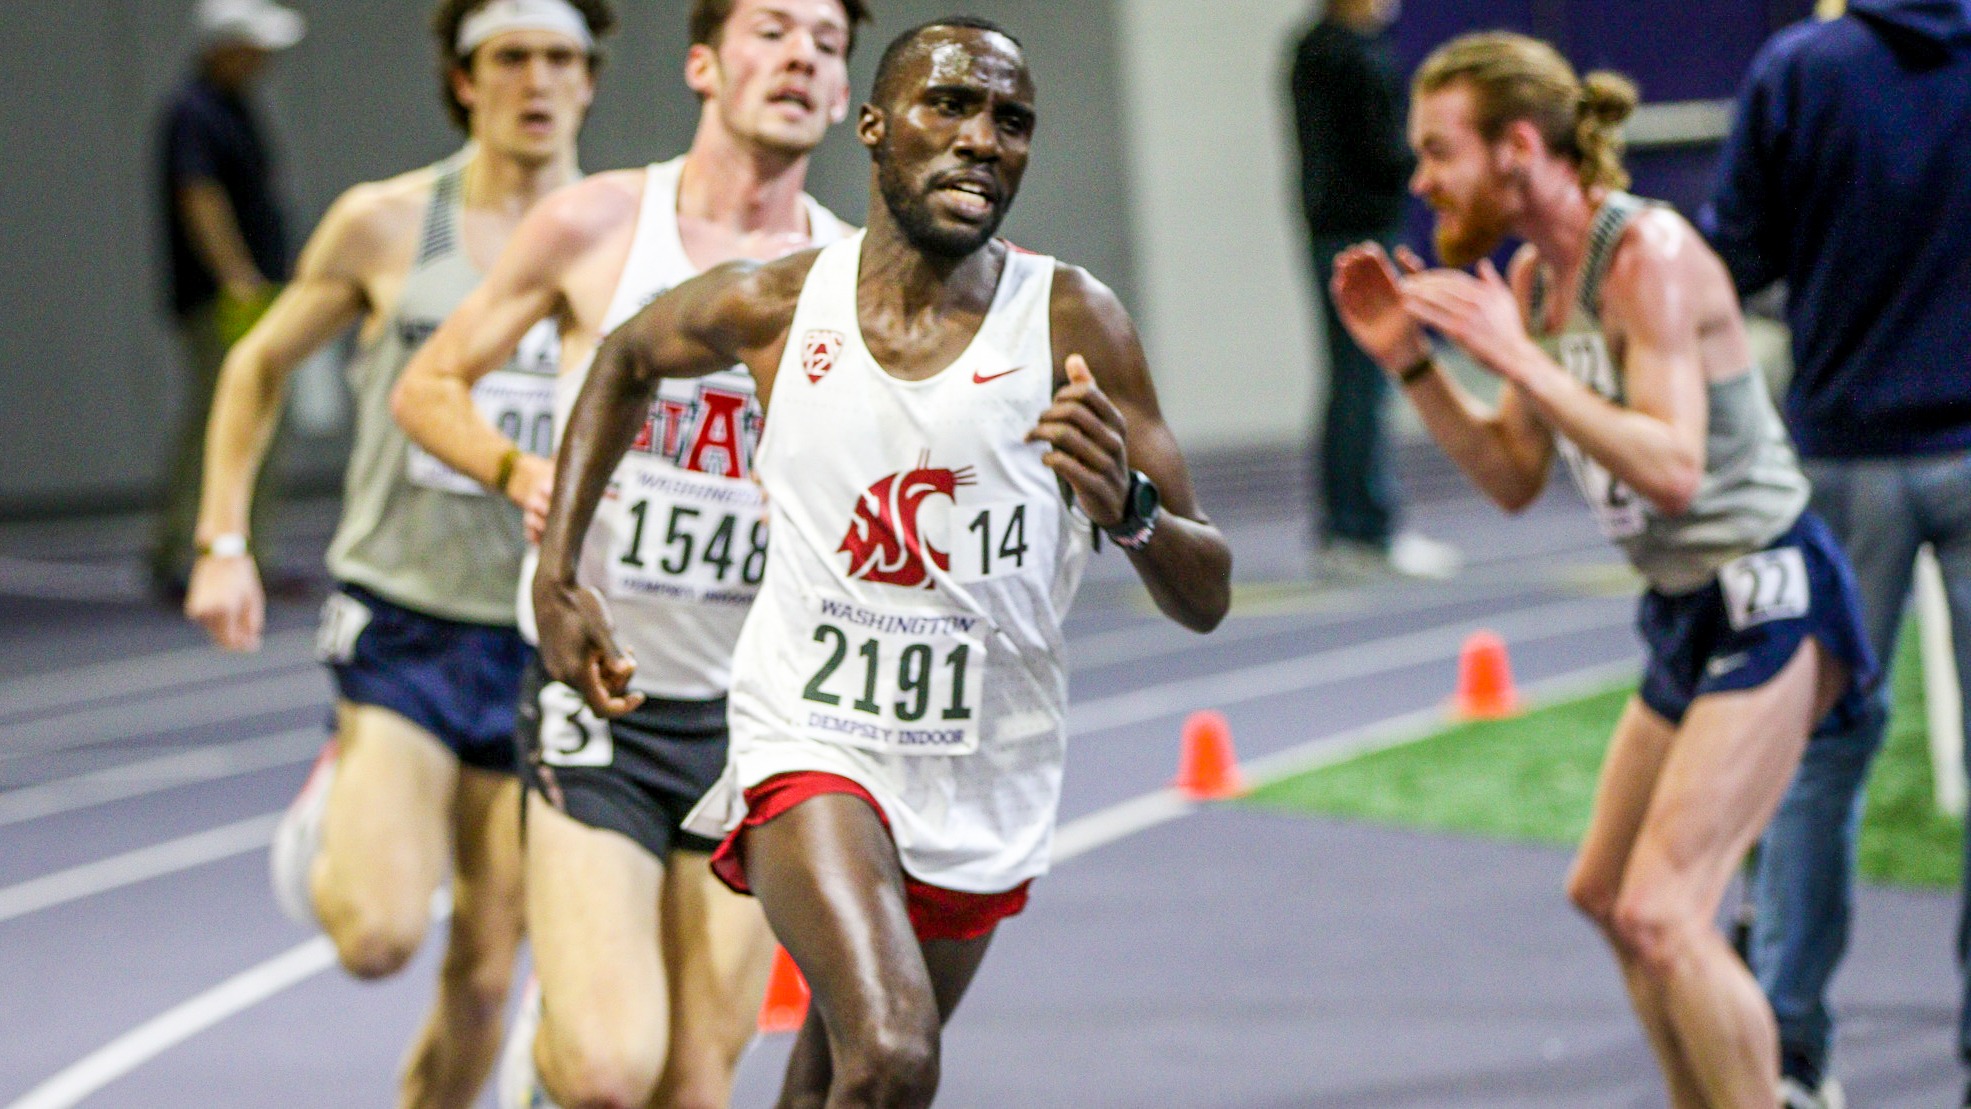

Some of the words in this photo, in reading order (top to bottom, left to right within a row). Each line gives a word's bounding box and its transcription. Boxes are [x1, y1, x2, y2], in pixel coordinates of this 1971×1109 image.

[620, 499, 768, 584] 1548
[968, 504, 1029, 575] 14
[820, 599, 975, 636] WASHINGTON
[802, 624, 972, 722] 2191
[808, 712, 892, 743] DEMPSEY
[898, 729, 966, 745] INDOOR
